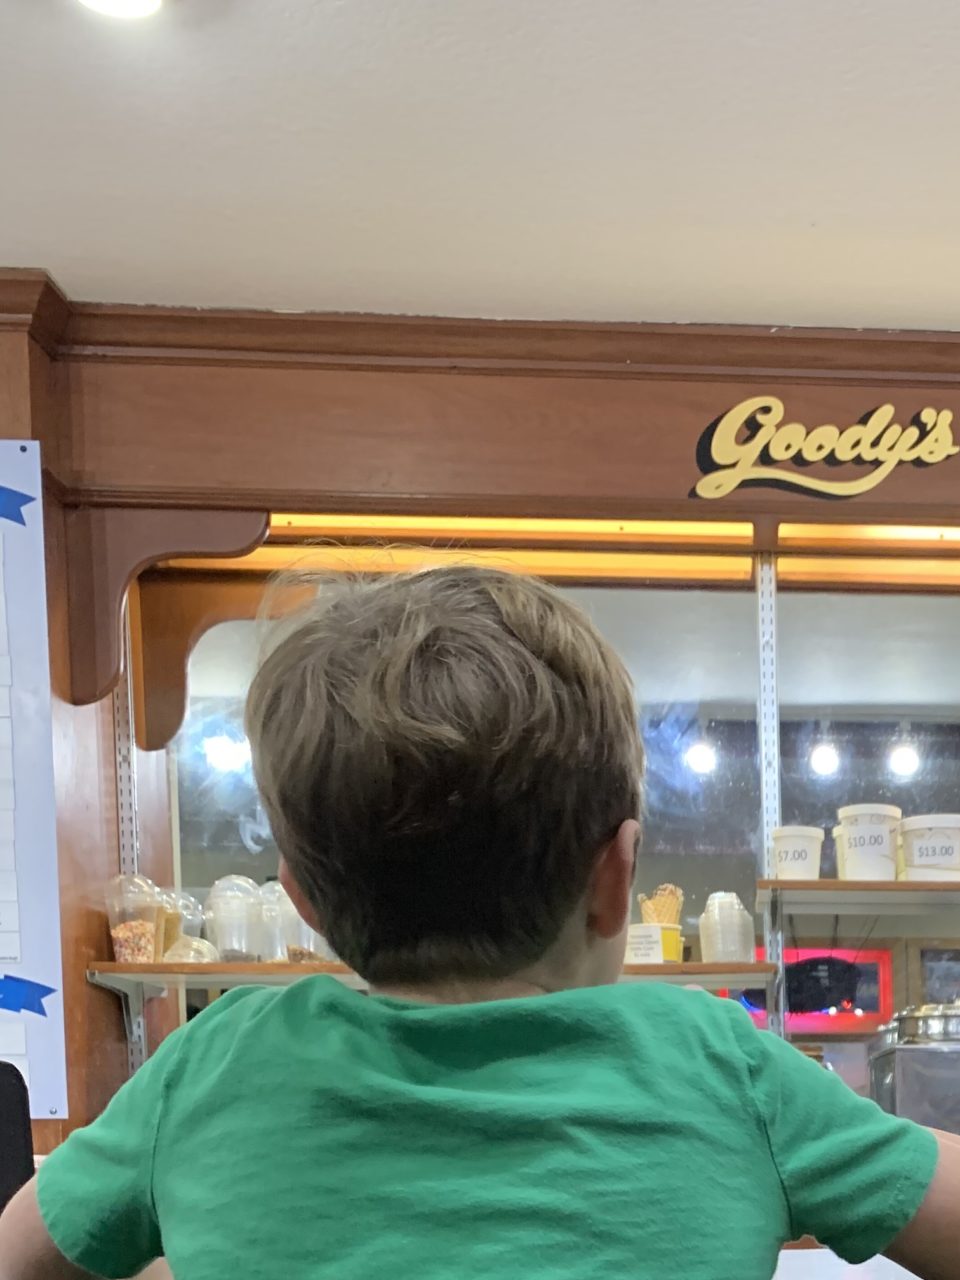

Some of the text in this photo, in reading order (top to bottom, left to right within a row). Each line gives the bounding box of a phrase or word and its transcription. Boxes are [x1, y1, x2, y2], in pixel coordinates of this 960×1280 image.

[694, 395, 960, 499] Goody's
[847, 834, 884, 849] $10.00
[777, 848, 808, 864] $7.00
[917, 845, 955, 858] $13.00
